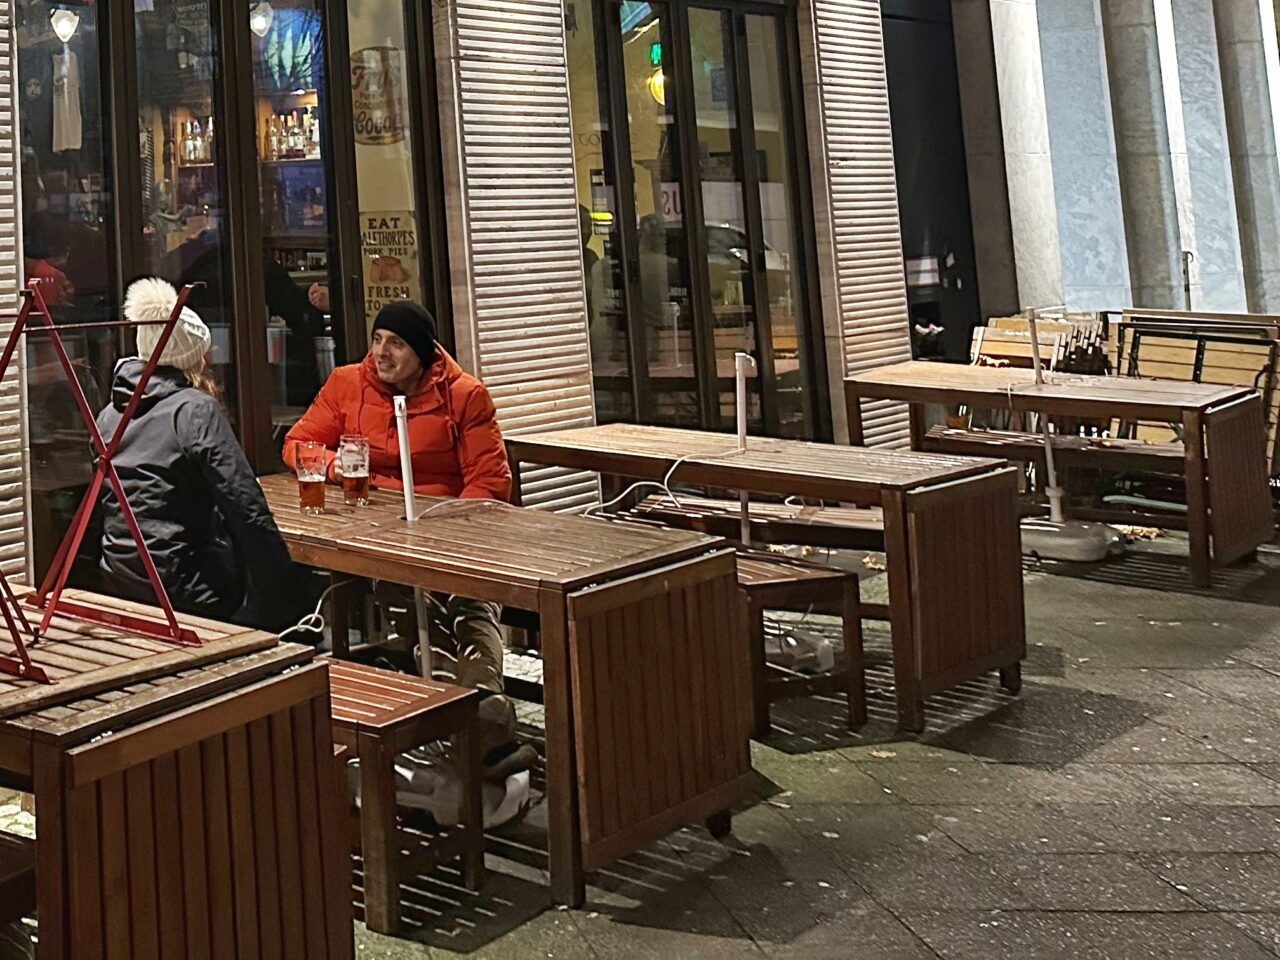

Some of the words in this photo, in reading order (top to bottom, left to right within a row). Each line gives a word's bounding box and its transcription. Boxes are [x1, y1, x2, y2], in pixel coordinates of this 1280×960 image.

[367, 217, 400, 230] EAT
[363, 247, 384, 256] PORK
[389, 247, 408, 256] PIES
[367, 286, 410, 298] FRESH
